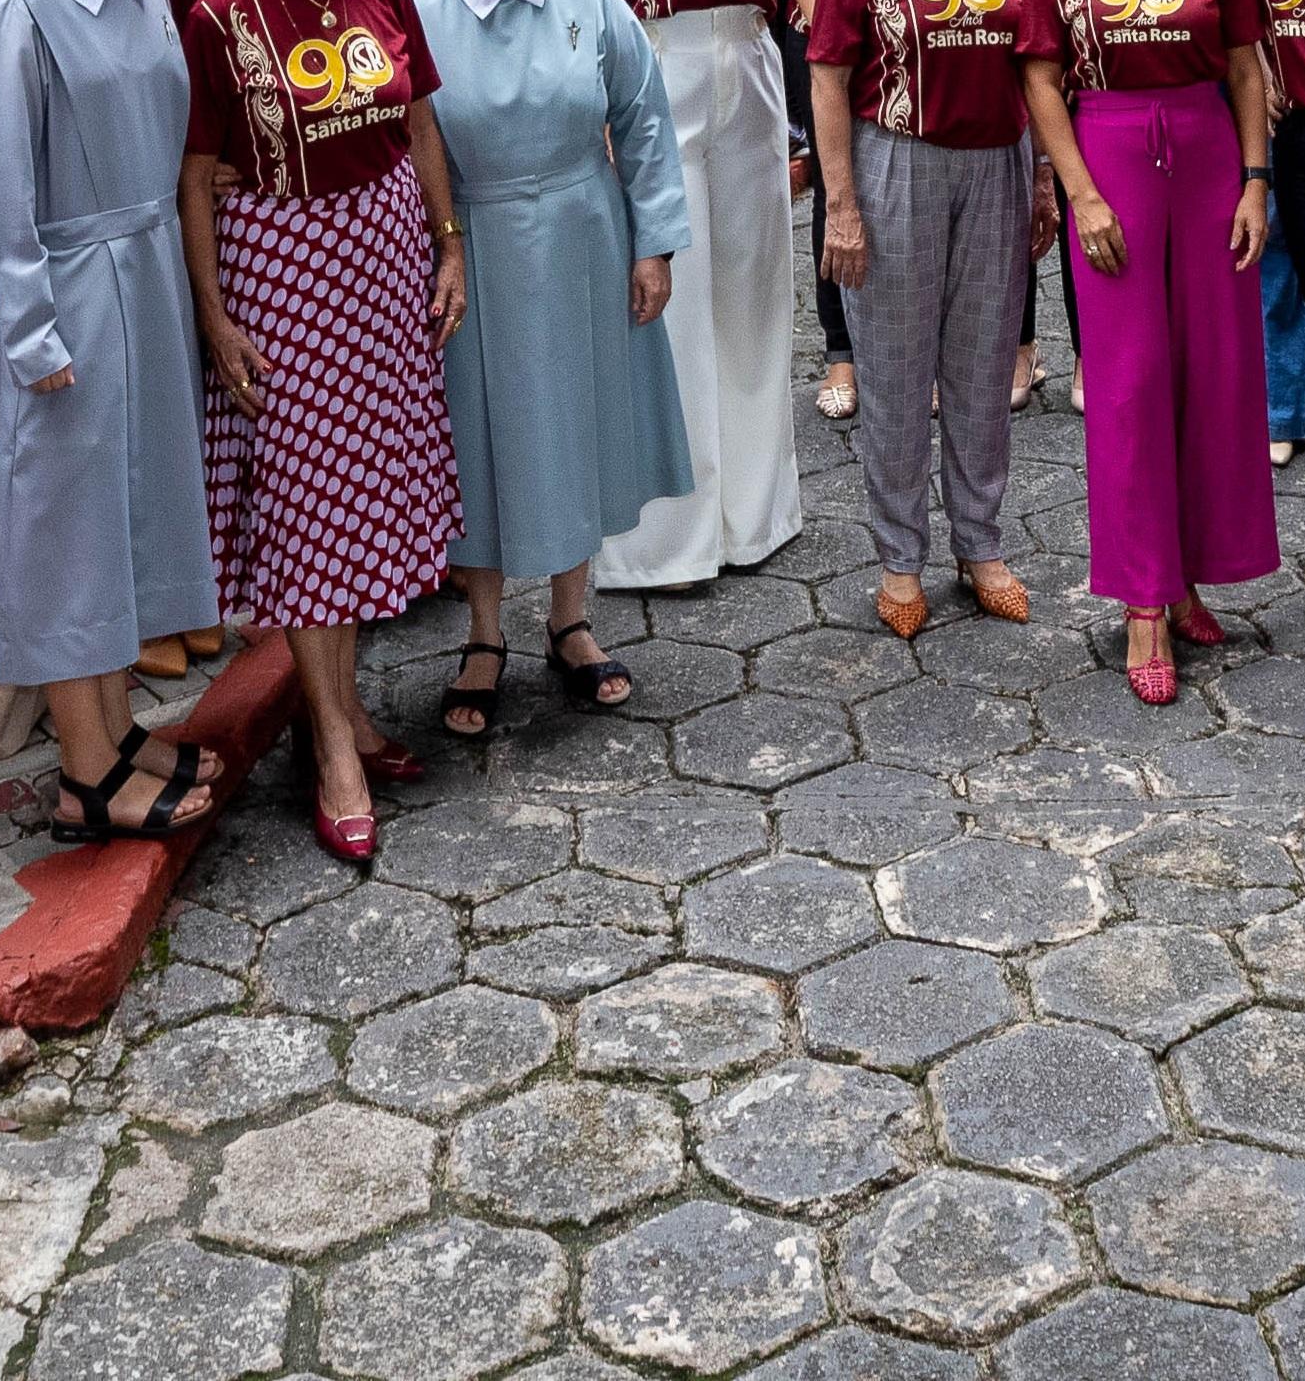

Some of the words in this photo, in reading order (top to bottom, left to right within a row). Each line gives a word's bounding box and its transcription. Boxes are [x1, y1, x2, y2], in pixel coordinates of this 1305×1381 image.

[927, 29, 972, 49] Santa
[975, 29, 1013, 45] Rosa
[1104, 29, 1148, 44] Santa
[1150, 28, 1191, 42] Rosa
[305, 114, 363, 143] Santa
[366, 105, 406, 125] Rosa
